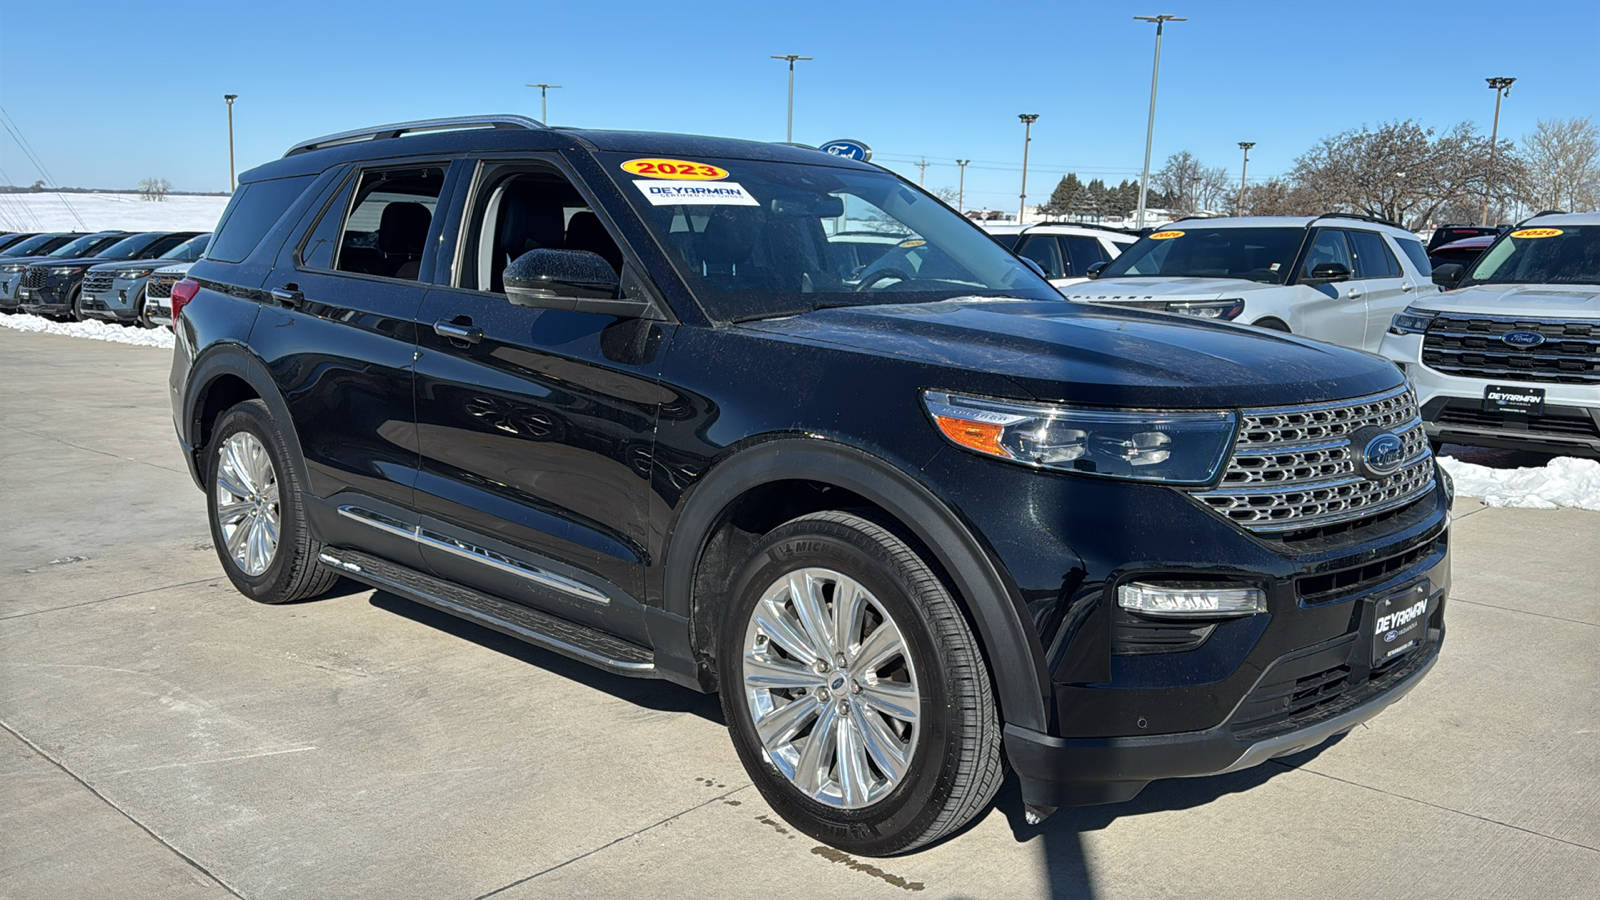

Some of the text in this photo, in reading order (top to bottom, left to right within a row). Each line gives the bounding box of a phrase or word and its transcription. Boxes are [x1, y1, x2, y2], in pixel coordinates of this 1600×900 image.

[636, 163, 719, 176] 2023
[649, 187, 742, 195] DEYARMAN
[1488, 392, 1541, 403] DEYARMAN
[1375, 598, 1428, 635] DEYARMAN
